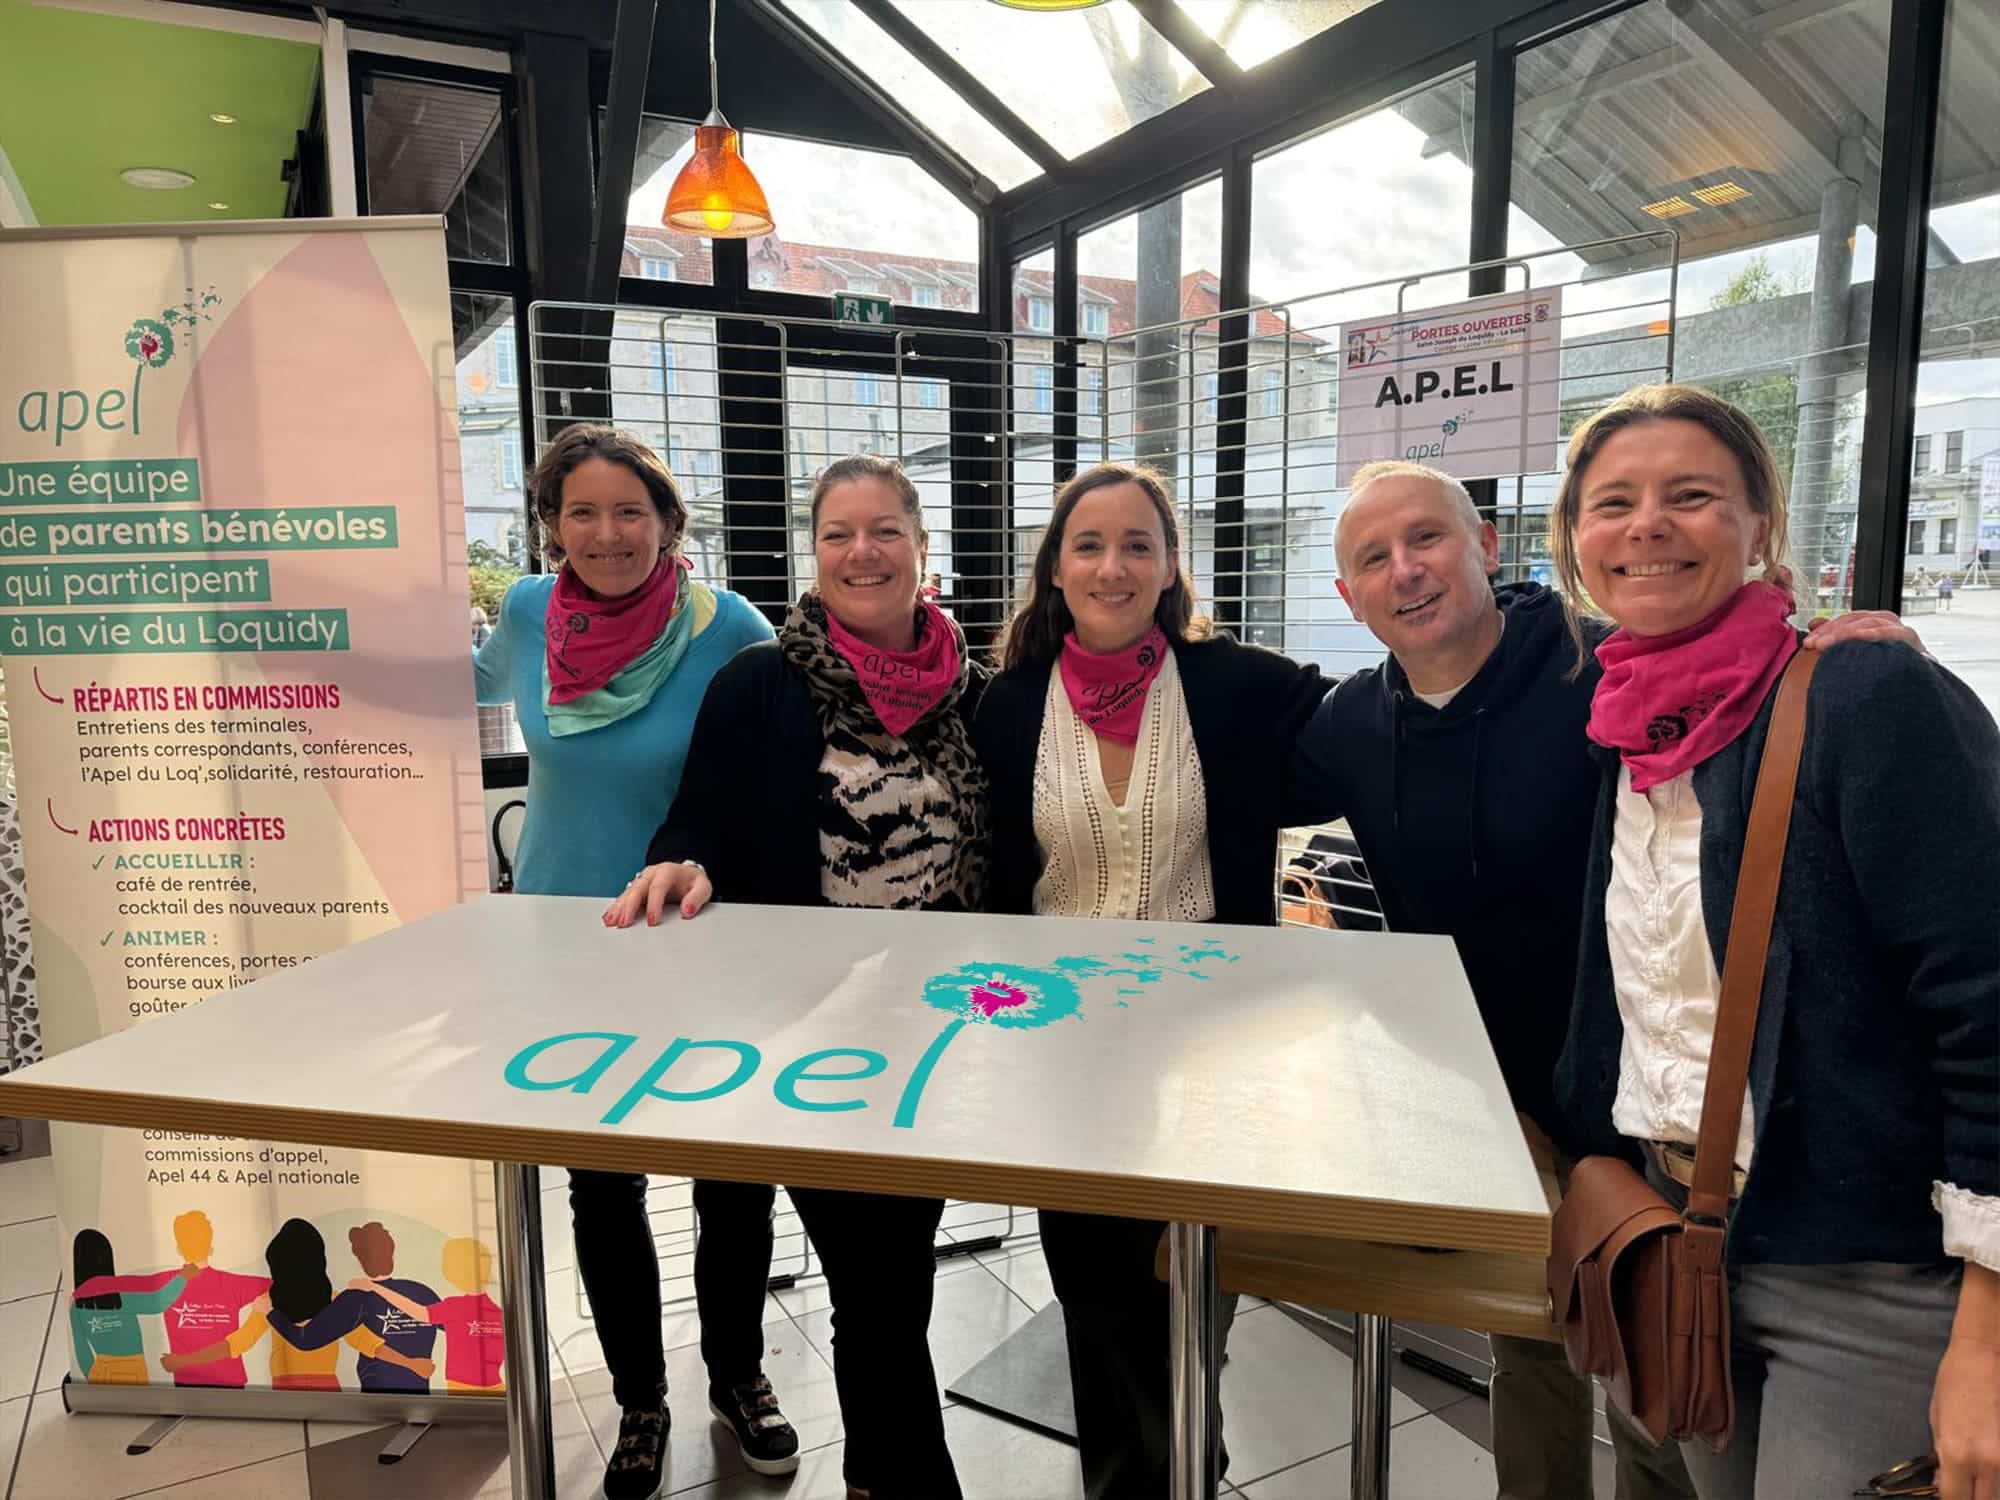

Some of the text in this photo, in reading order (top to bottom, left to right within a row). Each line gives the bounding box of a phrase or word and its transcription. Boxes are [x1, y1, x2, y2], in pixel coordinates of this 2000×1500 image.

[1411, 323, 1460, 342] PORTES
[1462, 312, 1532, 333] OUVERTES
[1374, 360, 1514, 409] A.P.E.L
[18, 365, 142, 447] apel
[1405, 432, 1450, 464] apel
[67, 461, 190, 503] équipe
[0, 509, 388, 554] de parents bénévoles
[5, 563, 259, 606] qui participent
[10, 611, 339, 651] à la vie du Loquidy
[73, 681, 341, 713] RÉPARTIS EN COMMISSIONS
[77, 717, 313, 736] Entretiens des terminales,
[79, 739, 414, 762] parents correspondants, conférences,
[81, 766, 131, 785] l'Apel
[136, 766, 161, 782] du
[88, 811, 286, 843] ACTIONS CONCRÈTES
[114, 853, 243, 870] ACCUEILLIR
[115, 876, 258, 894] café de rentrée,
[118, 898, 390, 918] cocktail des nouveaux parents
[122, 930, 207, 946] ANIMER
[123, 952, 236, 971] conférences,
[240, 954, 298, 972] portes
[126, 975, 187, 990] bourse
[191, 976, 225, 990] aux
[129, 997, 188, 1017] goûter
[503, 1019, 967, 1130] apel
[144, 1146, 329, 1167] commissions d'appel,
[147, 1168, 361, 1187] Apel 44 & Apel nationale
